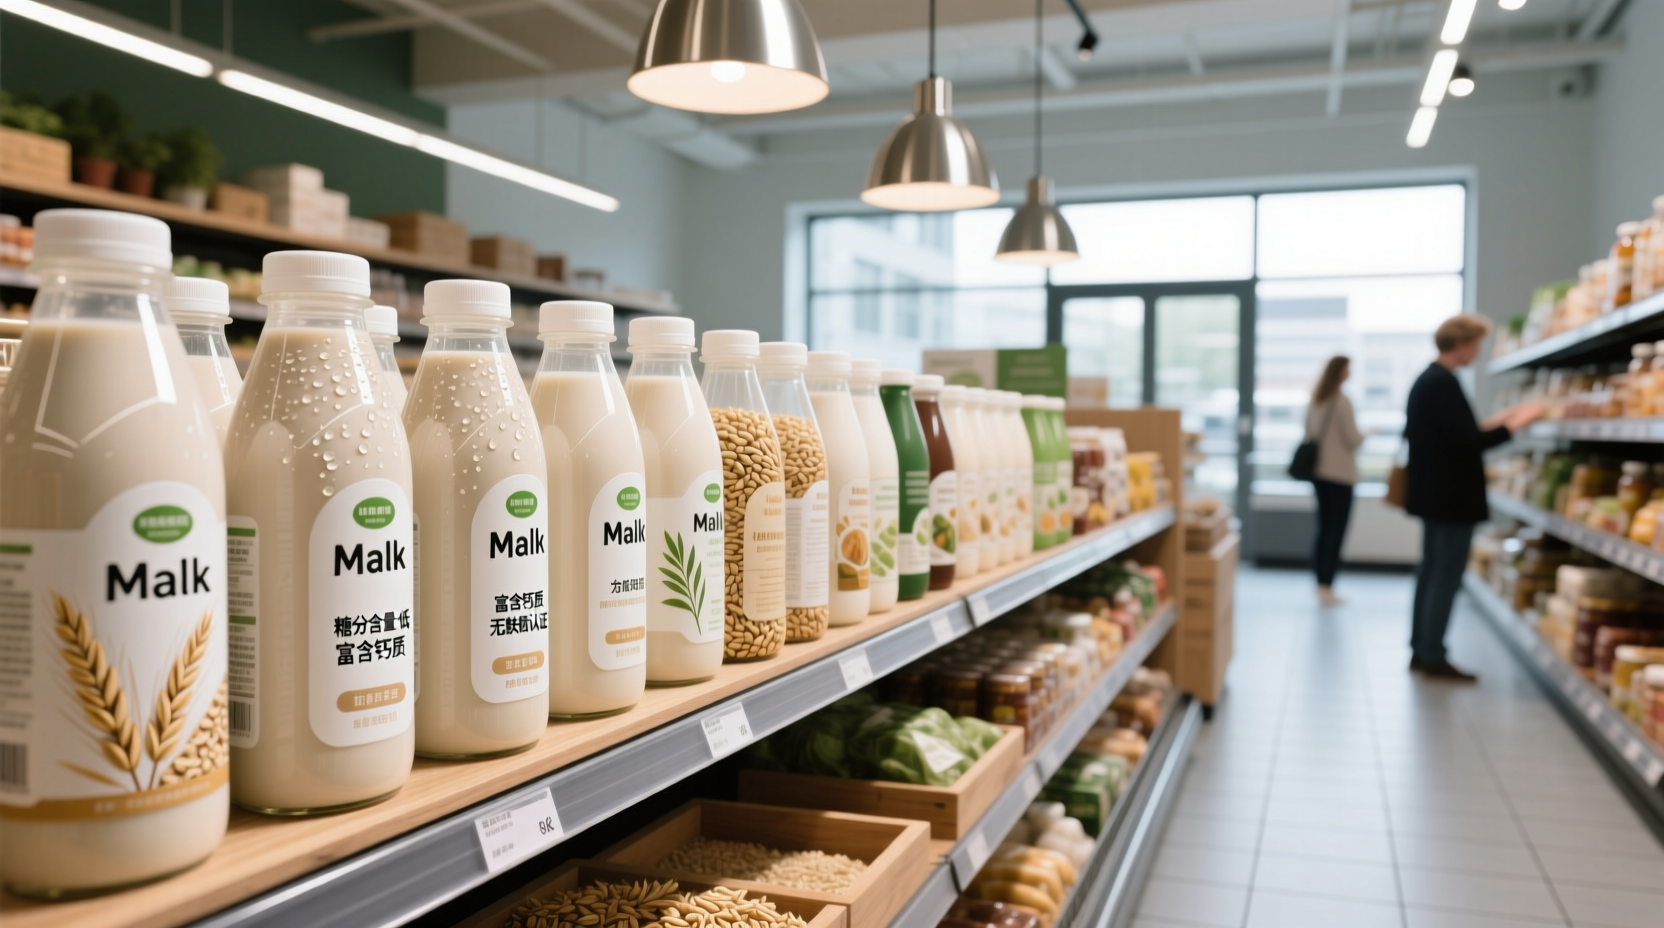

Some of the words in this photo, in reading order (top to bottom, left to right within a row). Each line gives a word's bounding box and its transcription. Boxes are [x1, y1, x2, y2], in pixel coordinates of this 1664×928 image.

[490, 527, 545, 559] Malk
[603, 518, 645, 546] Malk
[334, 540, 406, 577] Malk
[105, 557, 210, 603] Malk
[333, 608, 411, 638] 糖分含量低
[336, 634, 406, 667] 富含钙质
